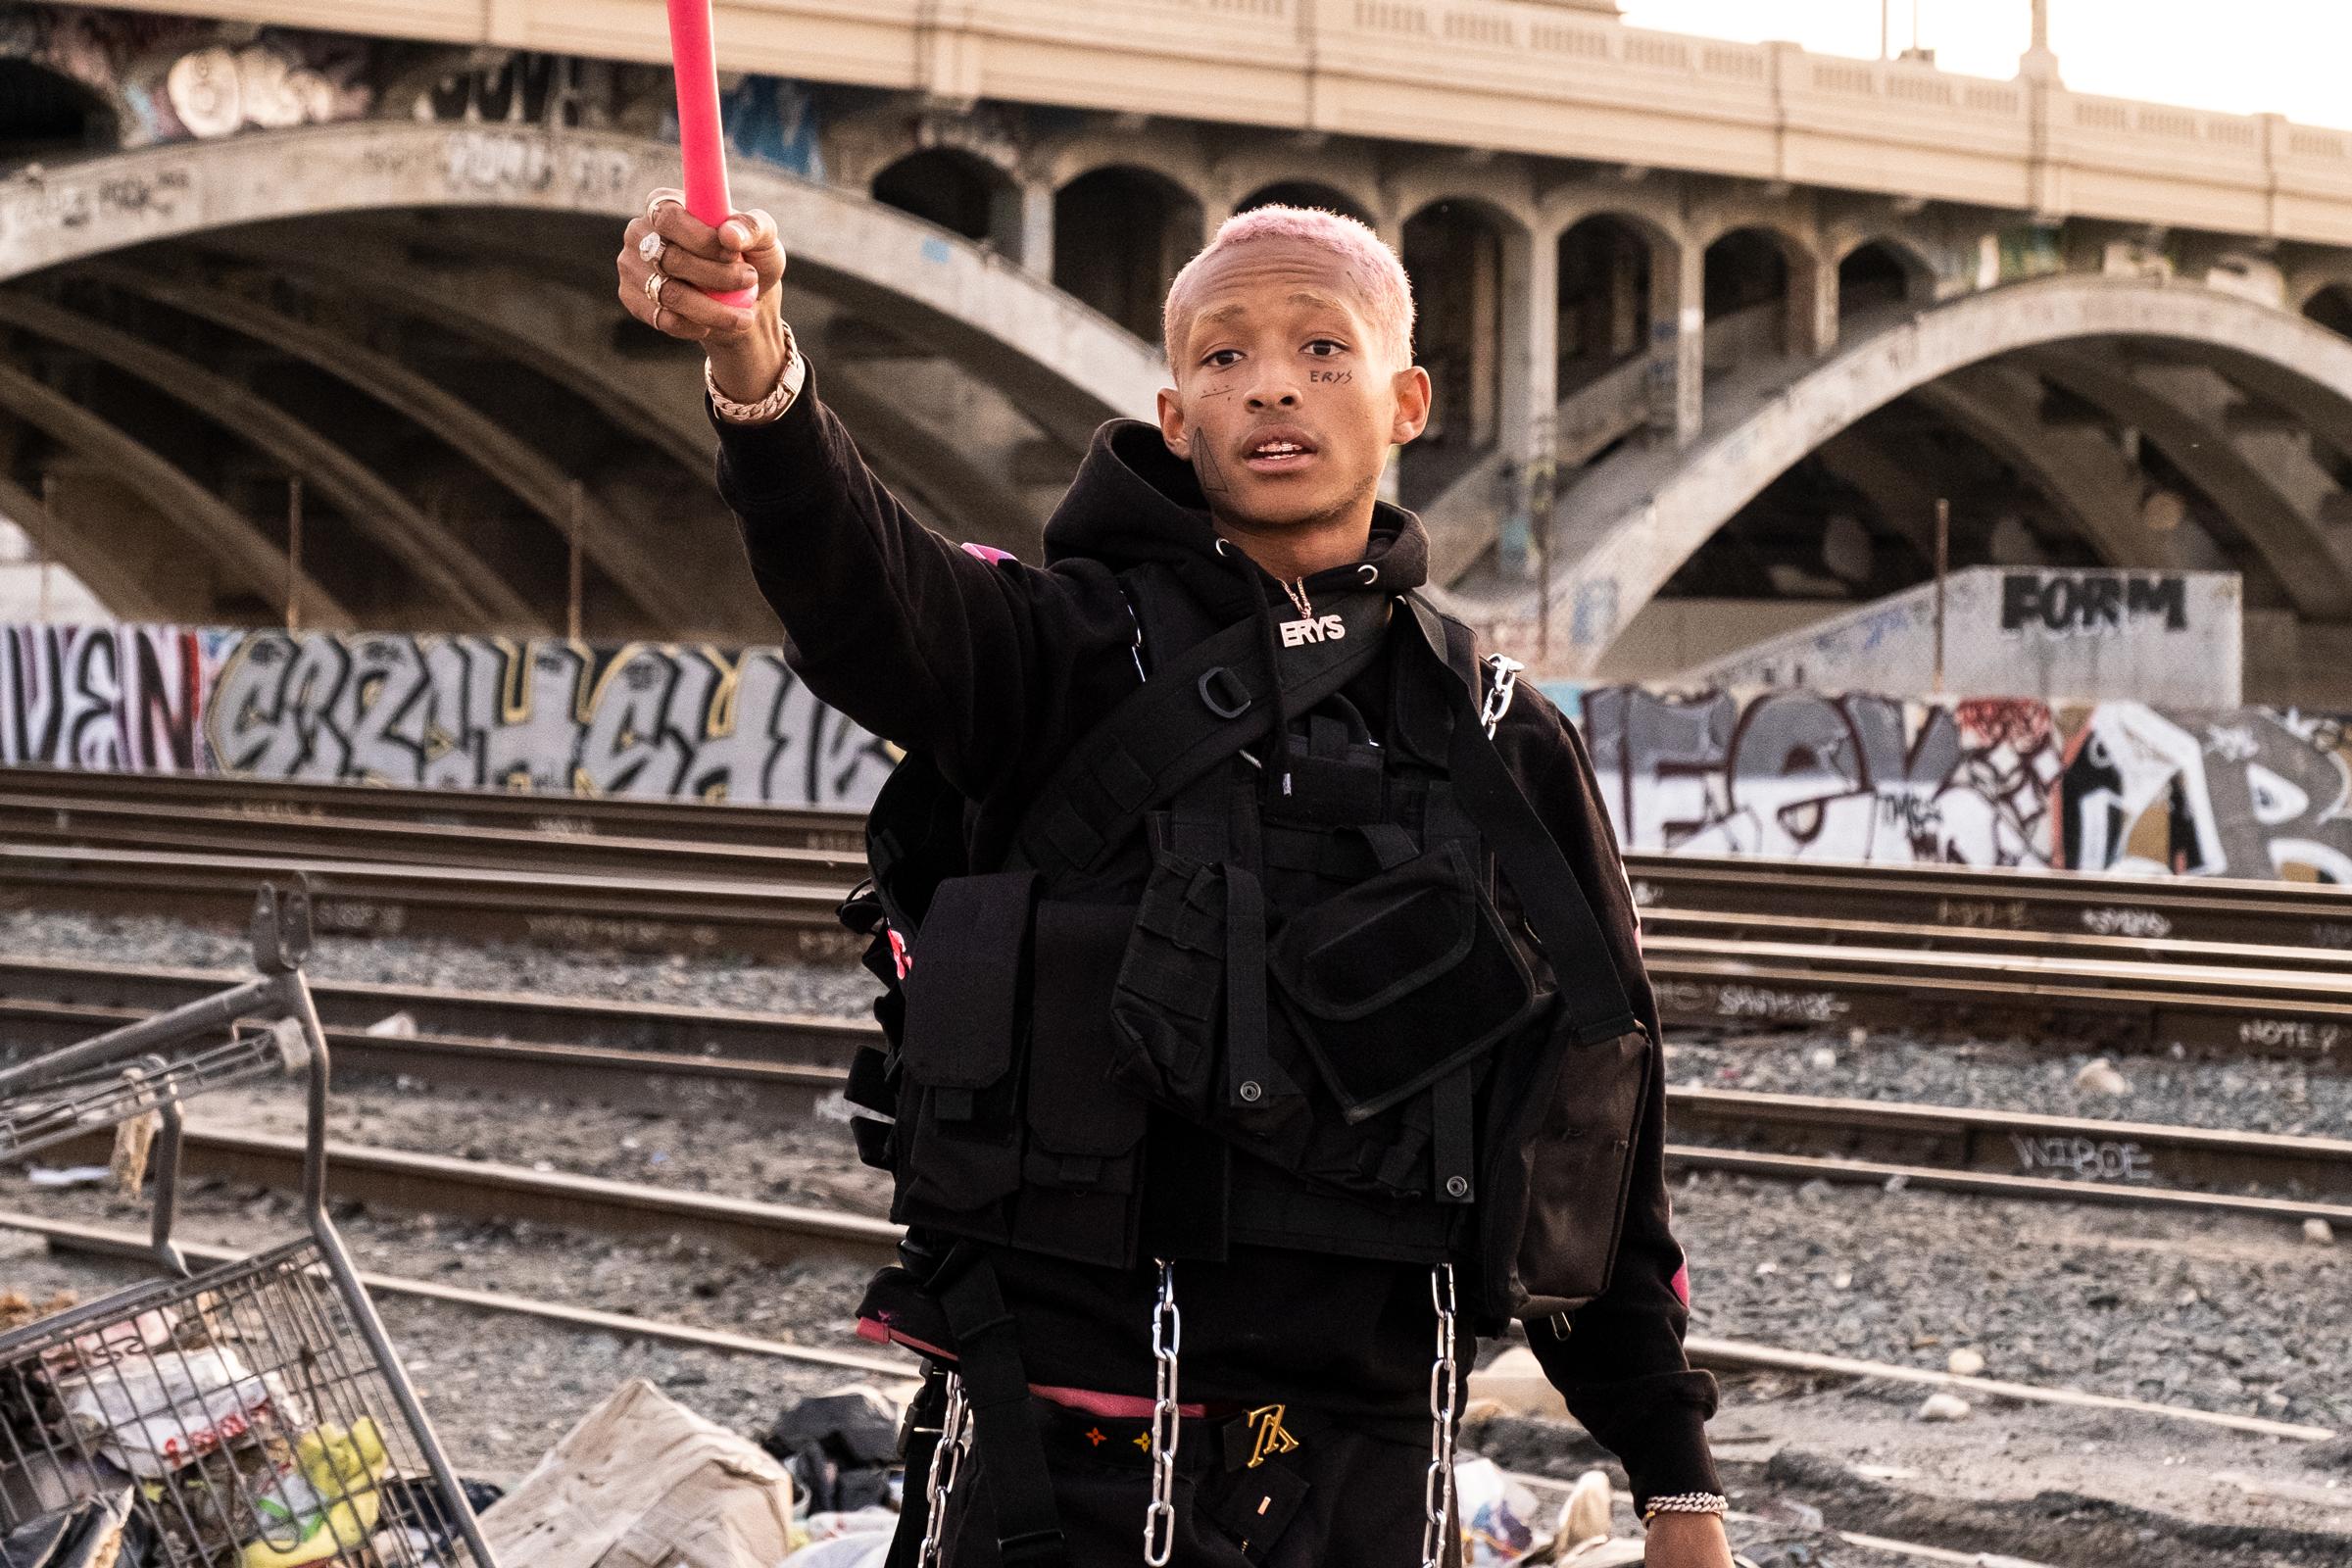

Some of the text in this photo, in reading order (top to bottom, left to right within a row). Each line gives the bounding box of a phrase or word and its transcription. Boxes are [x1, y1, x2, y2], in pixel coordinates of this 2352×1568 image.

[1309, 369, 1352, 384] ERYS
[2002, 574, 2187, 631] FORM
[1280, 614, 1346, 648] ERYS
